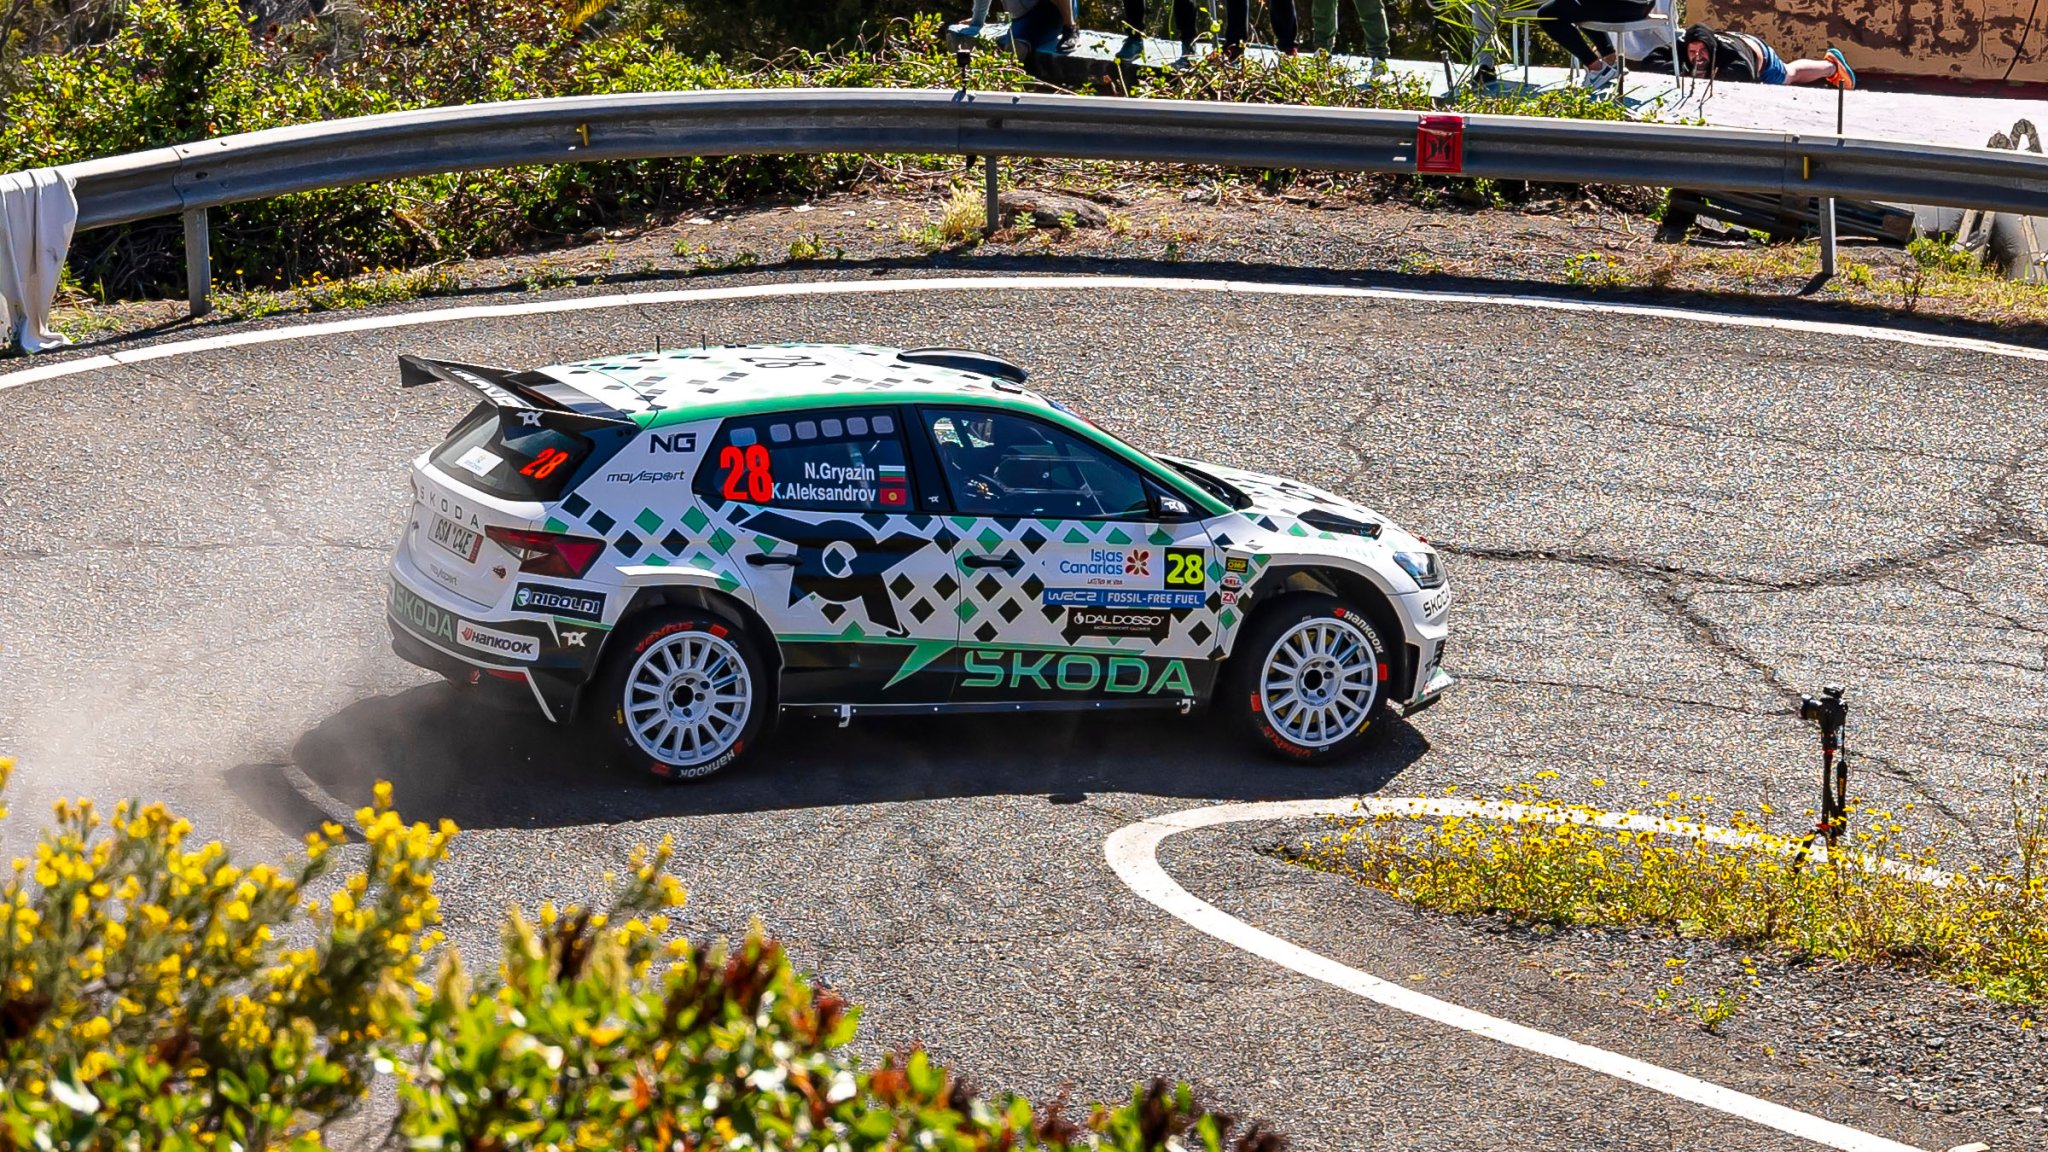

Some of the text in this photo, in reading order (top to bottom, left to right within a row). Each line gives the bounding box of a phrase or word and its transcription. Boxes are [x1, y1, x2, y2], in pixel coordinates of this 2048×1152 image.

[649, 432, 697, 454] NG
[519, 448, 570, 480] 28
[720, 444, 773, 503] 28
[804, 462, 875, 484] N.Gryazin
[606, 470, 686, 484] movisport
[771, 482, 876, 502] K.Aleksandrov
[1091, 549, 1123, 563] Islas
[1059, 560, 1124, 576] Canarias
[1167, 553, 1204, 585] 28
[530, 592, 600, 614] RIBOLDI
[1107, 594, 1172, 604] FOSSIL-FREE
[1174, 595, 1200, 605] FUEL
[1085, 614, 1112, 624] DAL
